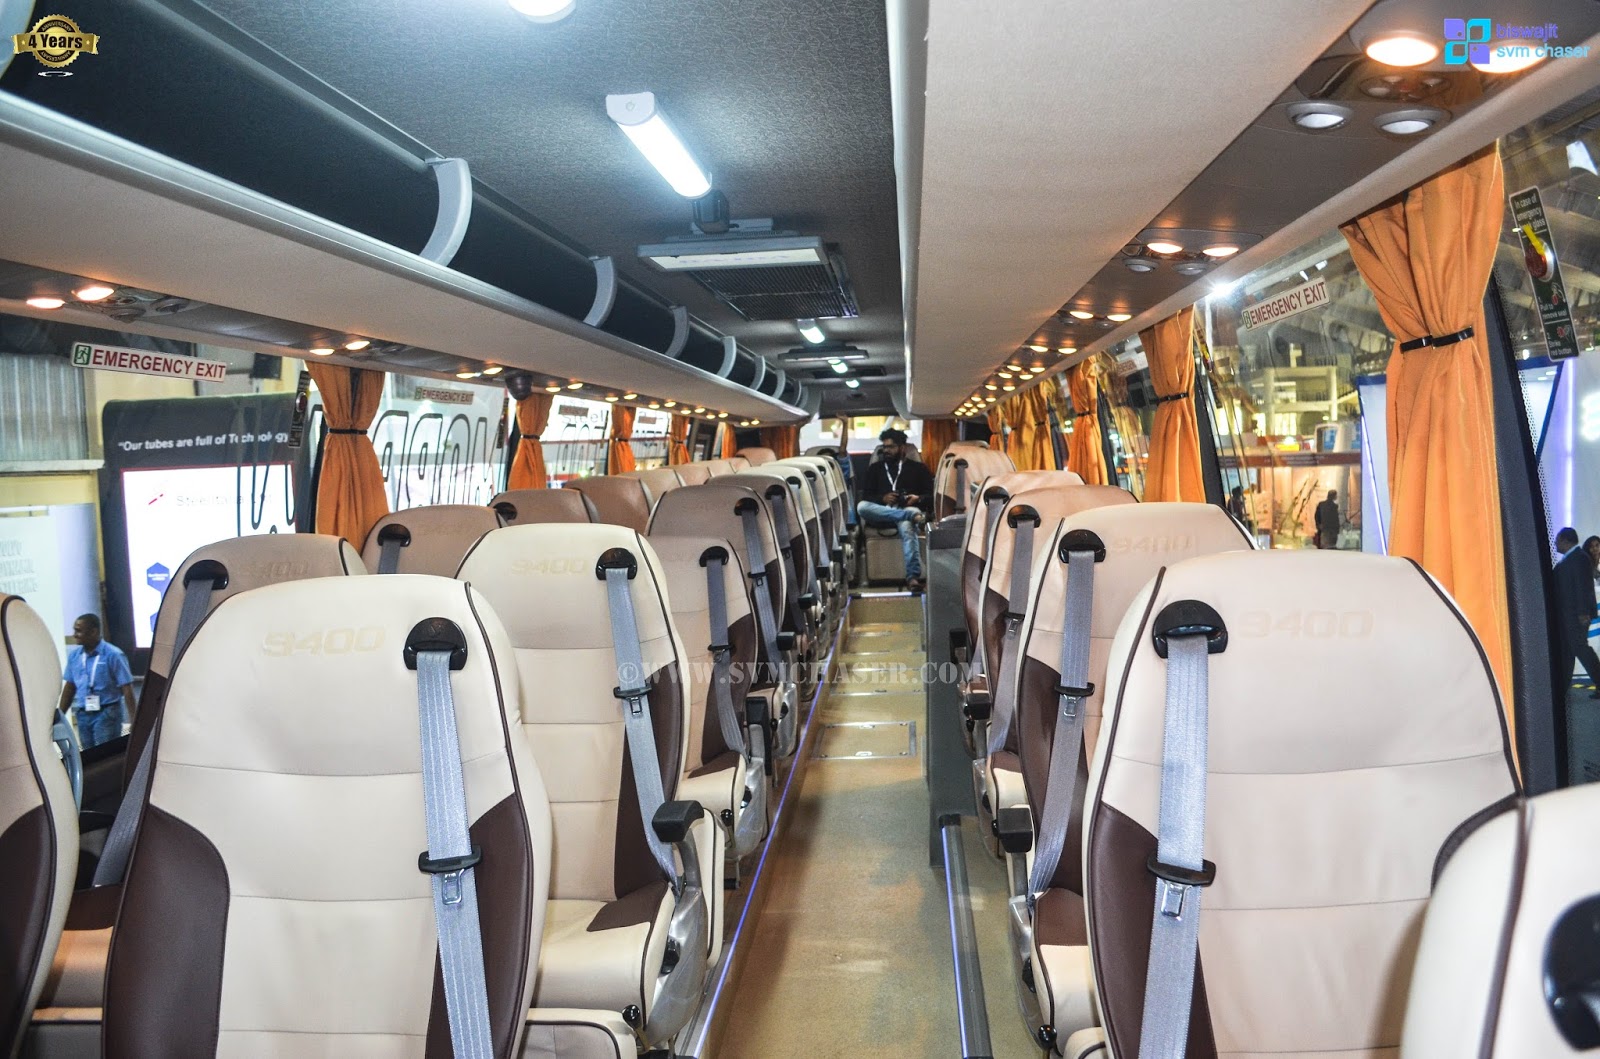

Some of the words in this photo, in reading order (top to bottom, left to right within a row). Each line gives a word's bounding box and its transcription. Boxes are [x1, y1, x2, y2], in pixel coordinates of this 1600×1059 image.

[1250, 291, 1302, 325] EMERGENCY
[1303, 282, 1327, 305] EXIT
[92, 348, 193, 375] EMERGENCY
[195, 362, 226, 379] EXIT
[422, 389, 459, 401] EMERGENCY
[145, 438, 174, 450] tubes
[176, 438, 193, 448] are
[195, 434, 213, 446] full
[214, 433, 226, 445] of
[511, 558, 585, 576] 9400
[1238, 610, 1374, 640] 9400
[262, 627, 386, 658] 9400
